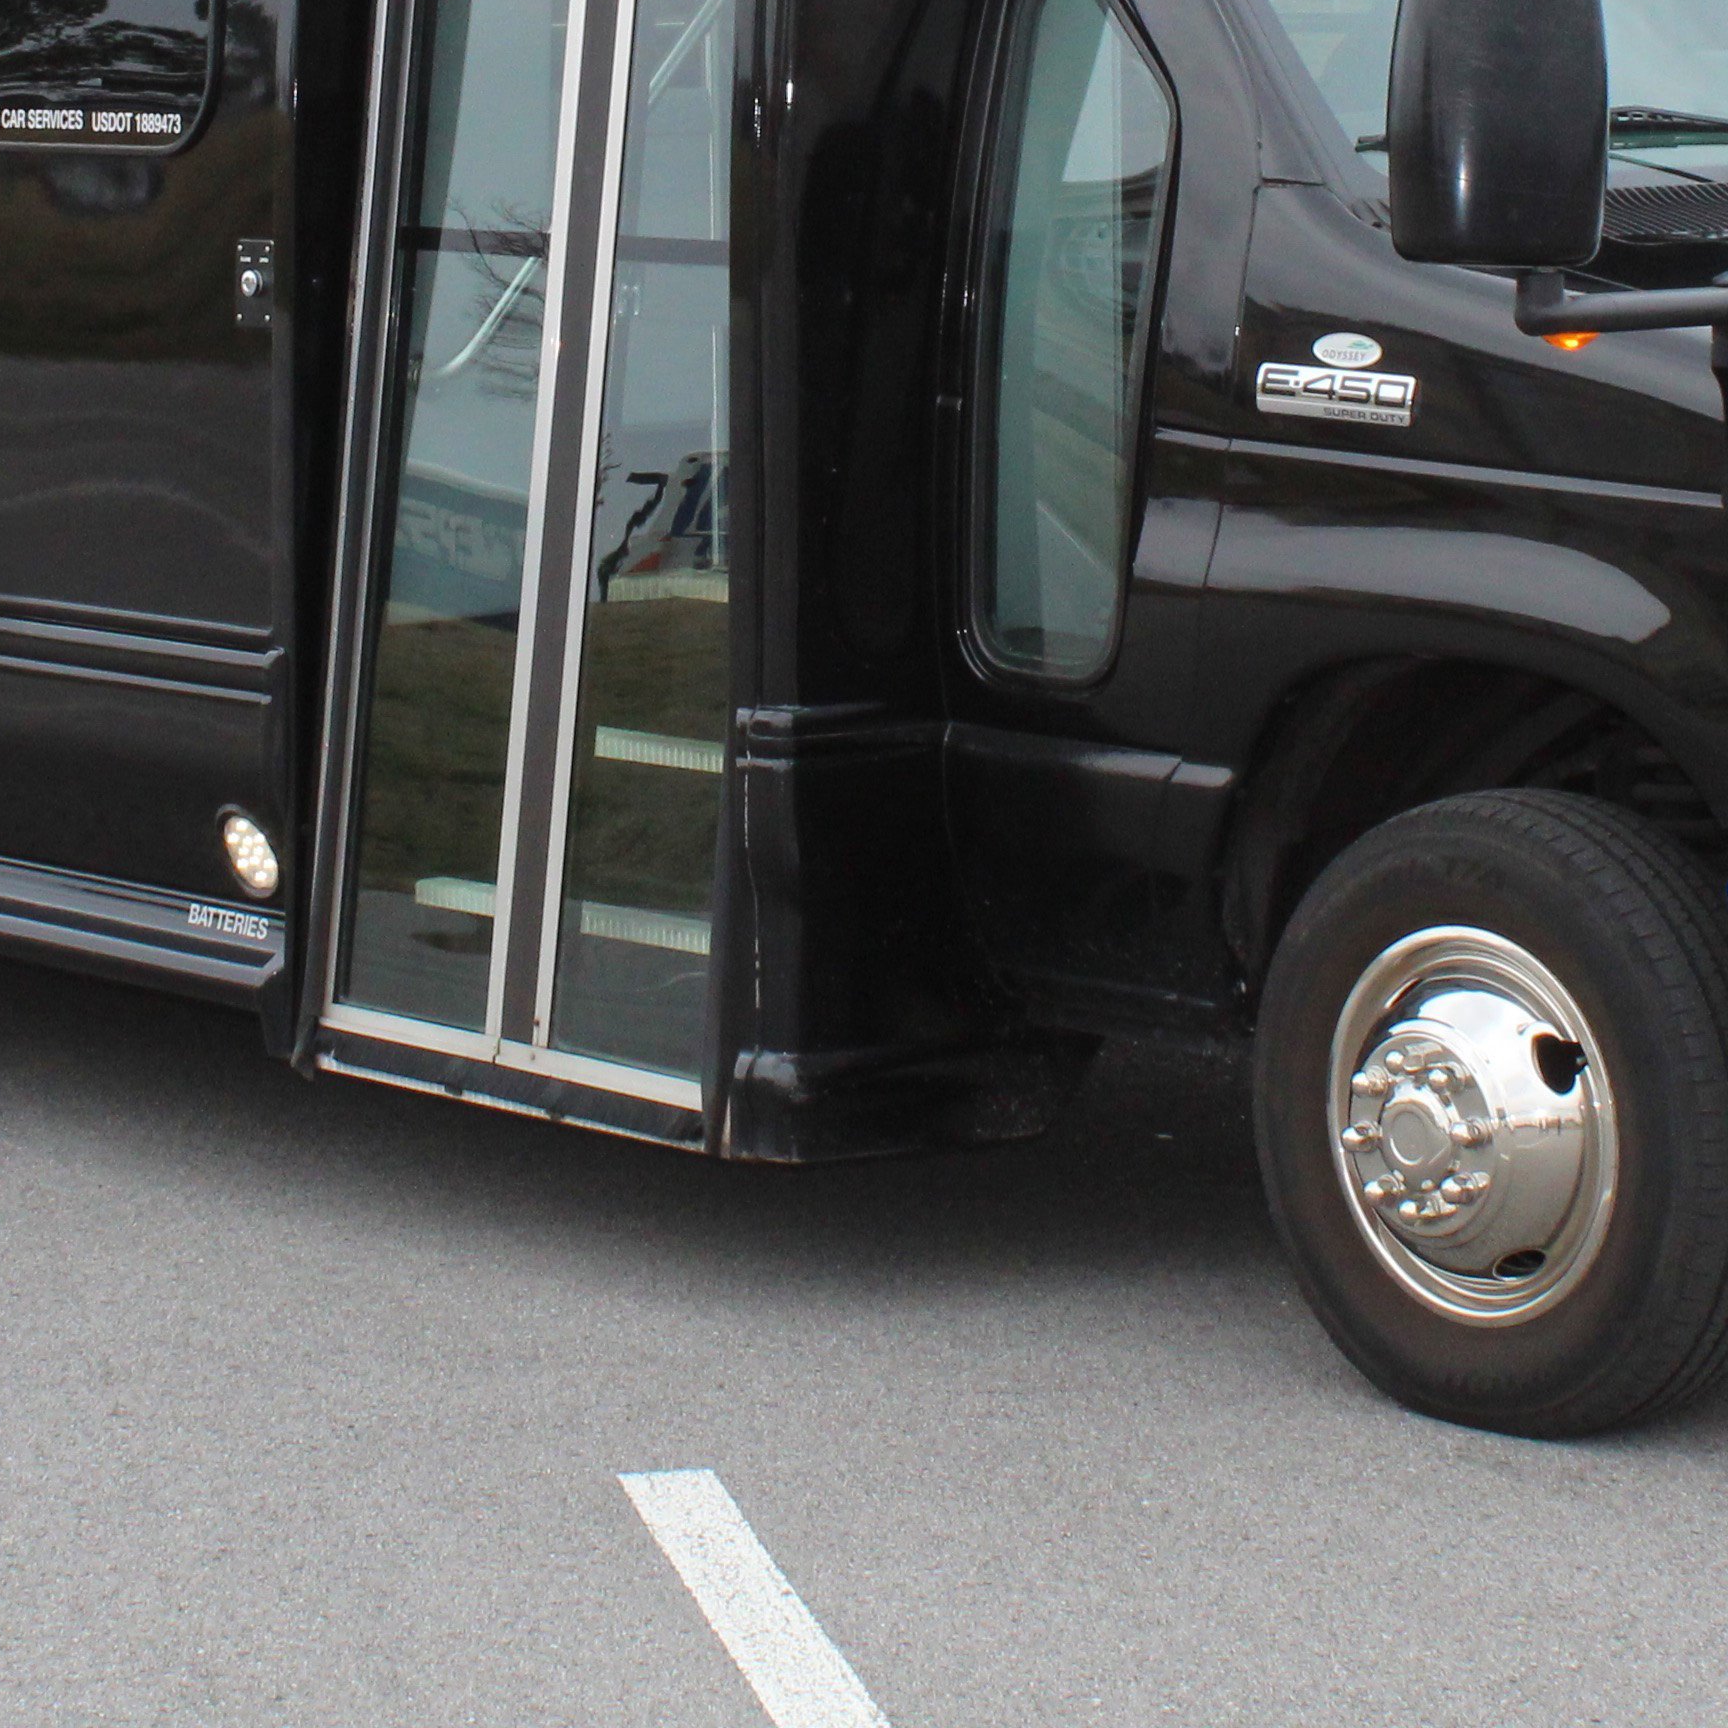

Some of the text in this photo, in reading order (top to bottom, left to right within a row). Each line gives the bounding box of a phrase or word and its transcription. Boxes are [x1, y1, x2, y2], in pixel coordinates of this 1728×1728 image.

[1, 109, 26, 130] CAR
[28, 109, 84, 131] SERVICES
[91, 112, 132, 133] USDOT
[1321, 348, 1367, 362] ODYSSEY
[1323, 407, 1406, 424] SUPER DUTY
[188, 903, 269, 940] BATTERIES
